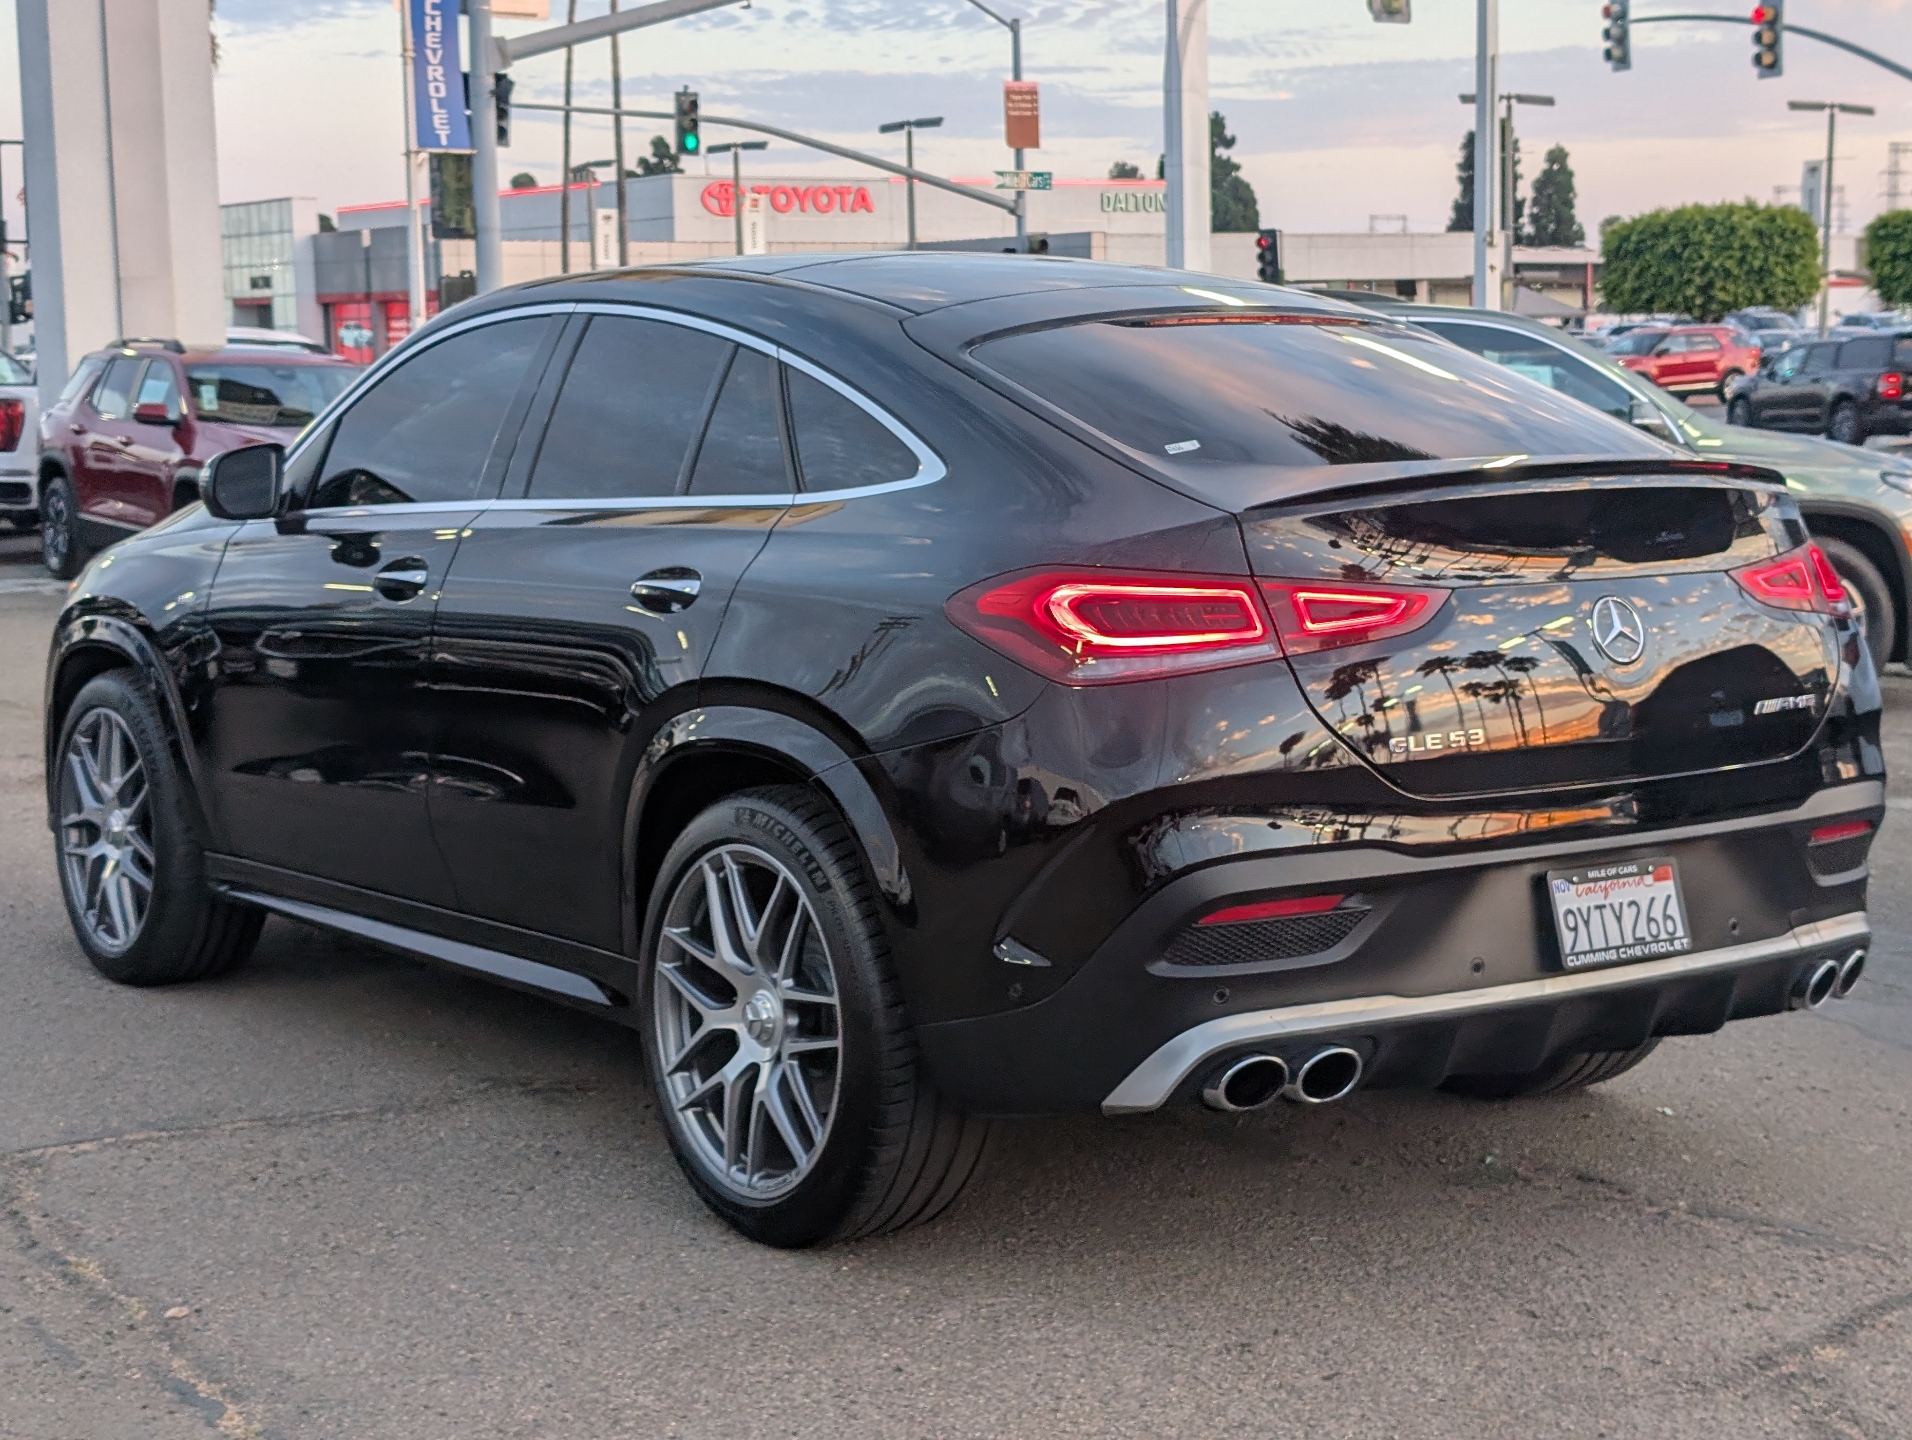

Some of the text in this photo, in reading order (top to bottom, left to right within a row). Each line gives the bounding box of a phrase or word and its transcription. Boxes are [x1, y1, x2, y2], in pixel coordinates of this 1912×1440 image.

[424, 0, 451, 146] CHEVROLET
[752, 185, 875, 213] TOYOTA
[1101, 192, 1167, 212] DALTON
[1389, 728, 1485, 752] GLE 53
[752, 811, 830, 889] MICHELIN
[1588, 865, 1638, 878] MILE OF CARS
[1553, 880, 1570, 894] NOV
[1563, 894, 1677, 952] 9YTY266
[1566, 938, 1690, 967] CUMMING CHEVROLET
